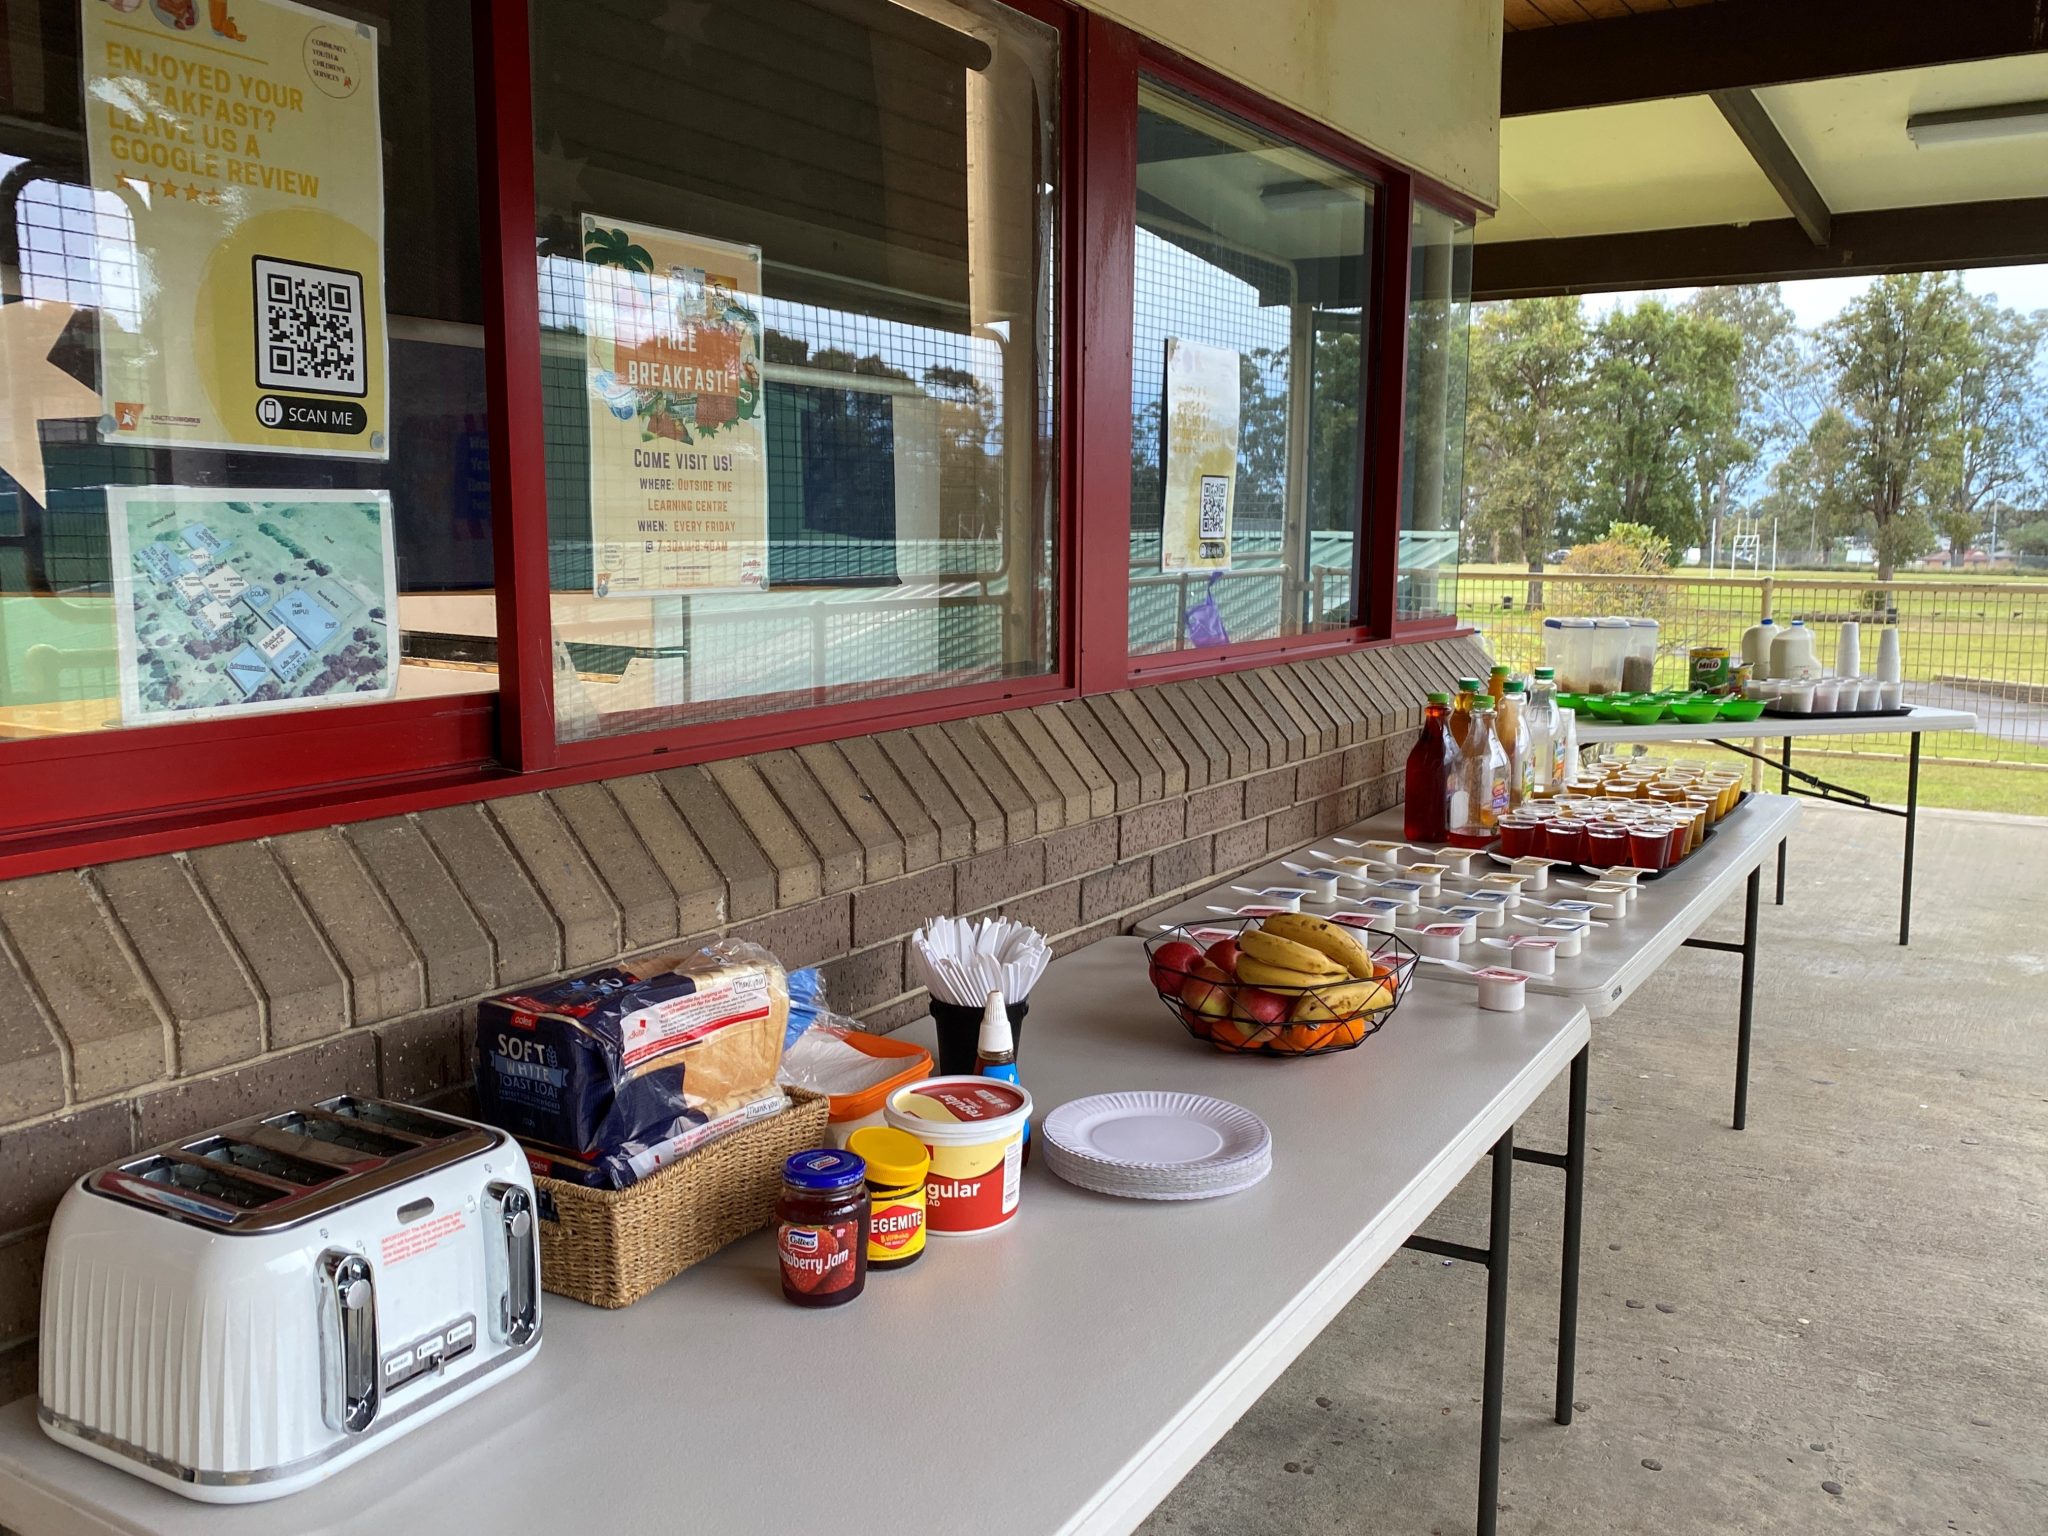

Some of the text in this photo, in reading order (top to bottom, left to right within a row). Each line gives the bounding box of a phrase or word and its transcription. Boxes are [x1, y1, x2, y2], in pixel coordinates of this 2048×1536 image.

[106, 42, 304, 113] ENJOYED YOUR
[204, 124, 237, 153] US
[245, 134, 260, 159] A
[110, 134, 319, 199] GOOGLE REVIEW
[628, 360, 729, 394] BREAKFAST!
[289, 407, 353, 427] SCAN ME
[634, 448, 733, 472] COME VISIT US!
[639, 477, 733, 492] WHERE: OUTSIDE THE
[647, 499, 728, 512] LEARNING CENTRE
[637, 519, 736, 532] WHEN: EVERY FRIDAY
[514, 1016, 533, 1027] coles
[498, 1033, 546, 1065] SOFT
[506, 1060, 550, 1081] WHITE
[768, 1101, 779, 1112] you
[927, 1181, 981, 1199] gular
[870, 1210, 922, 1234] EGEMITE
[824, 1248, 849, 1270] Jam
